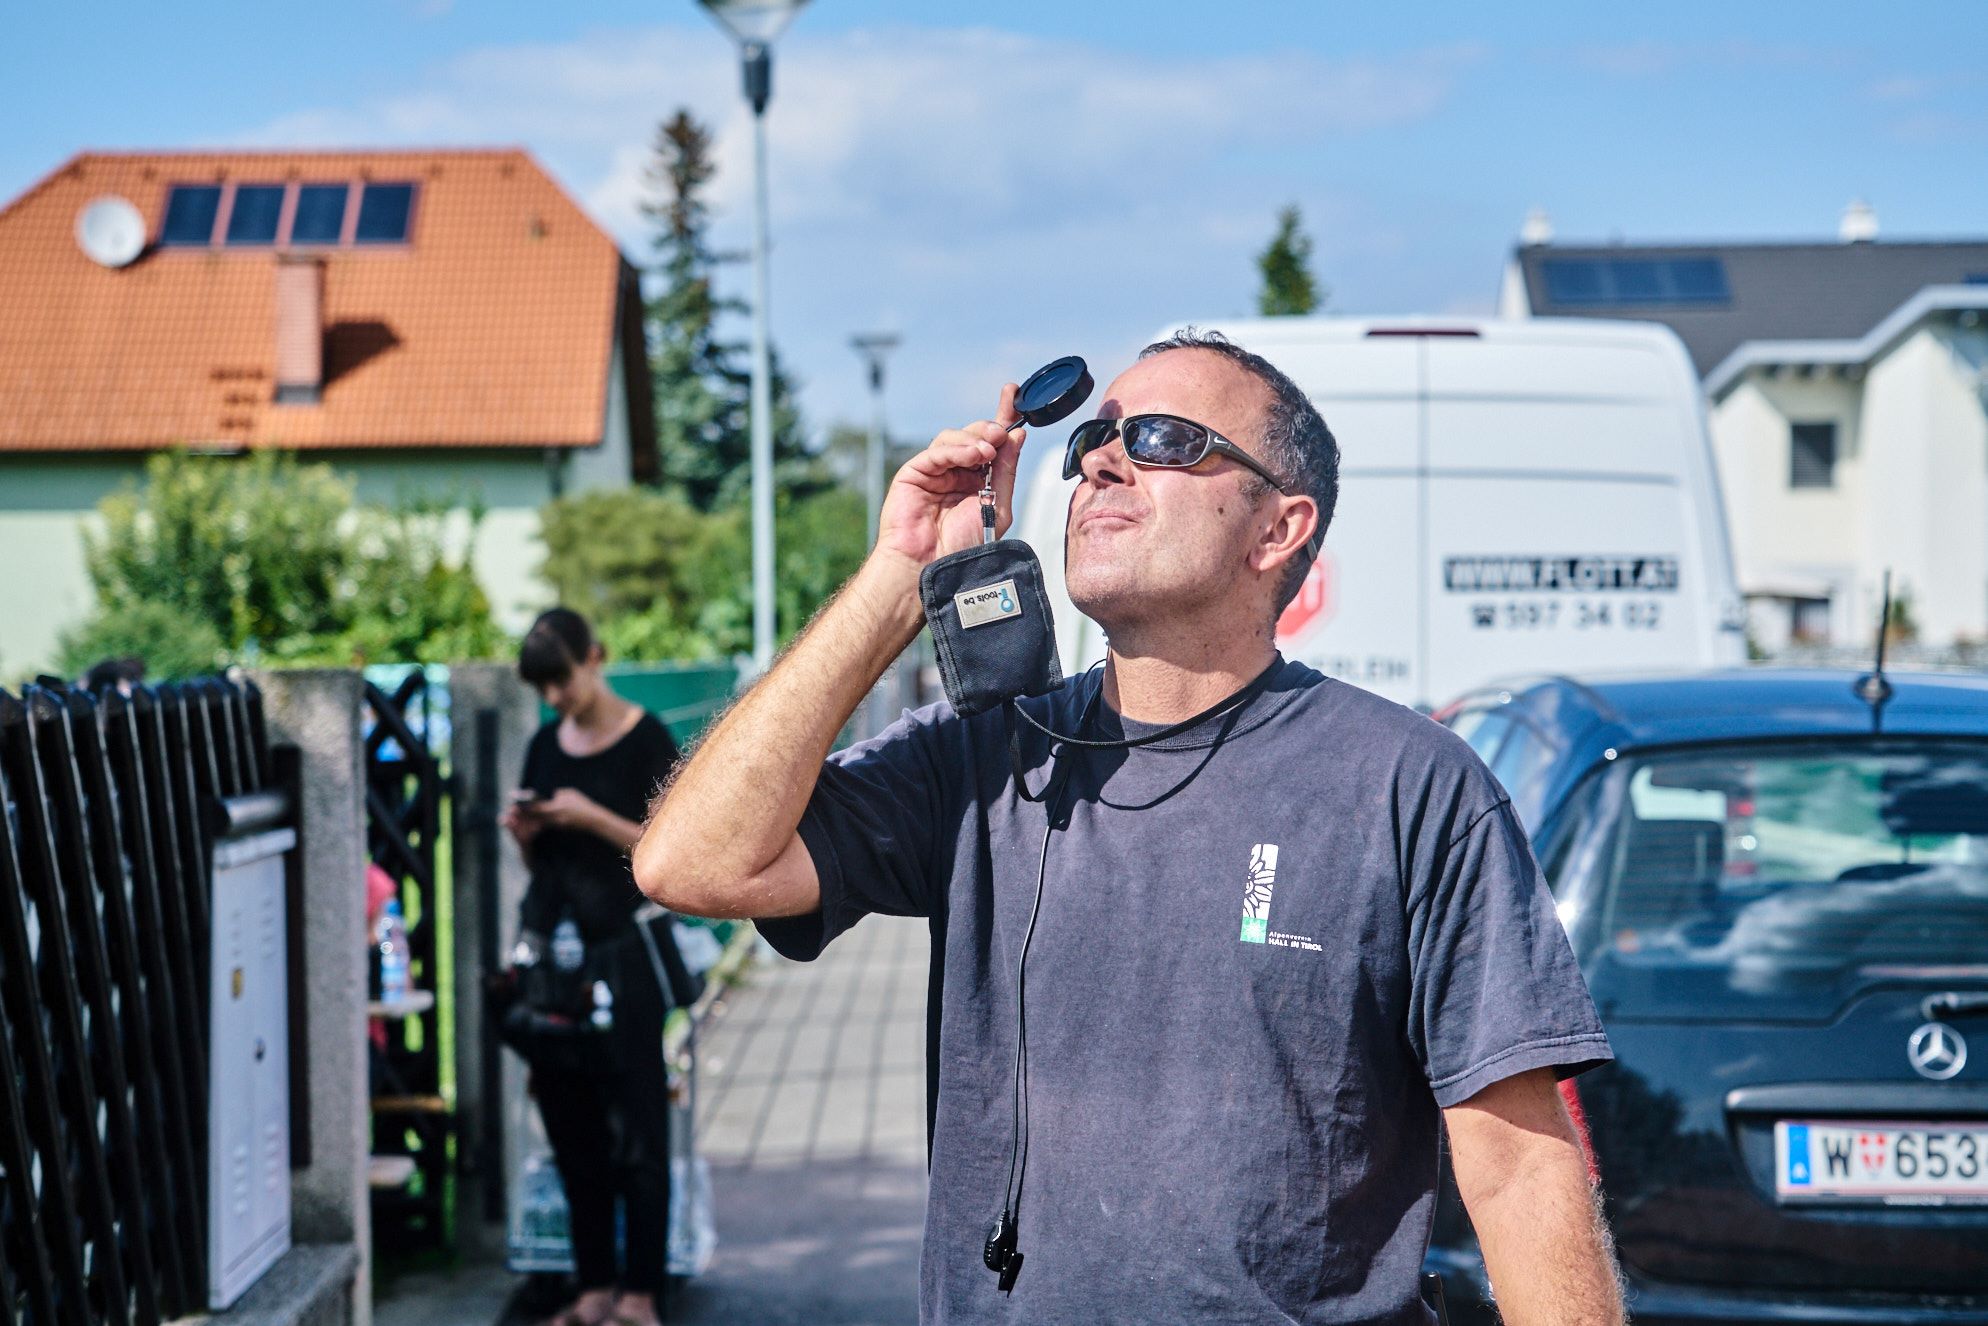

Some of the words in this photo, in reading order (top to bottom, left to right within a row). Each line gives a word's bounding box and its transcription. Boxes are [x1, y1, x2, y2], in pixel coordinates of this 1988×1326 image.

[1575, 602, 1611, 627] 34
[1268, 938, 1288, 947] HALL
[1290, 941, 1299, 949] IN
[1300, 942, 1323, 952] TIROL
[1823, 1134, 1852, 1177] W
[1895, 1133, 1988, 1179] 653
